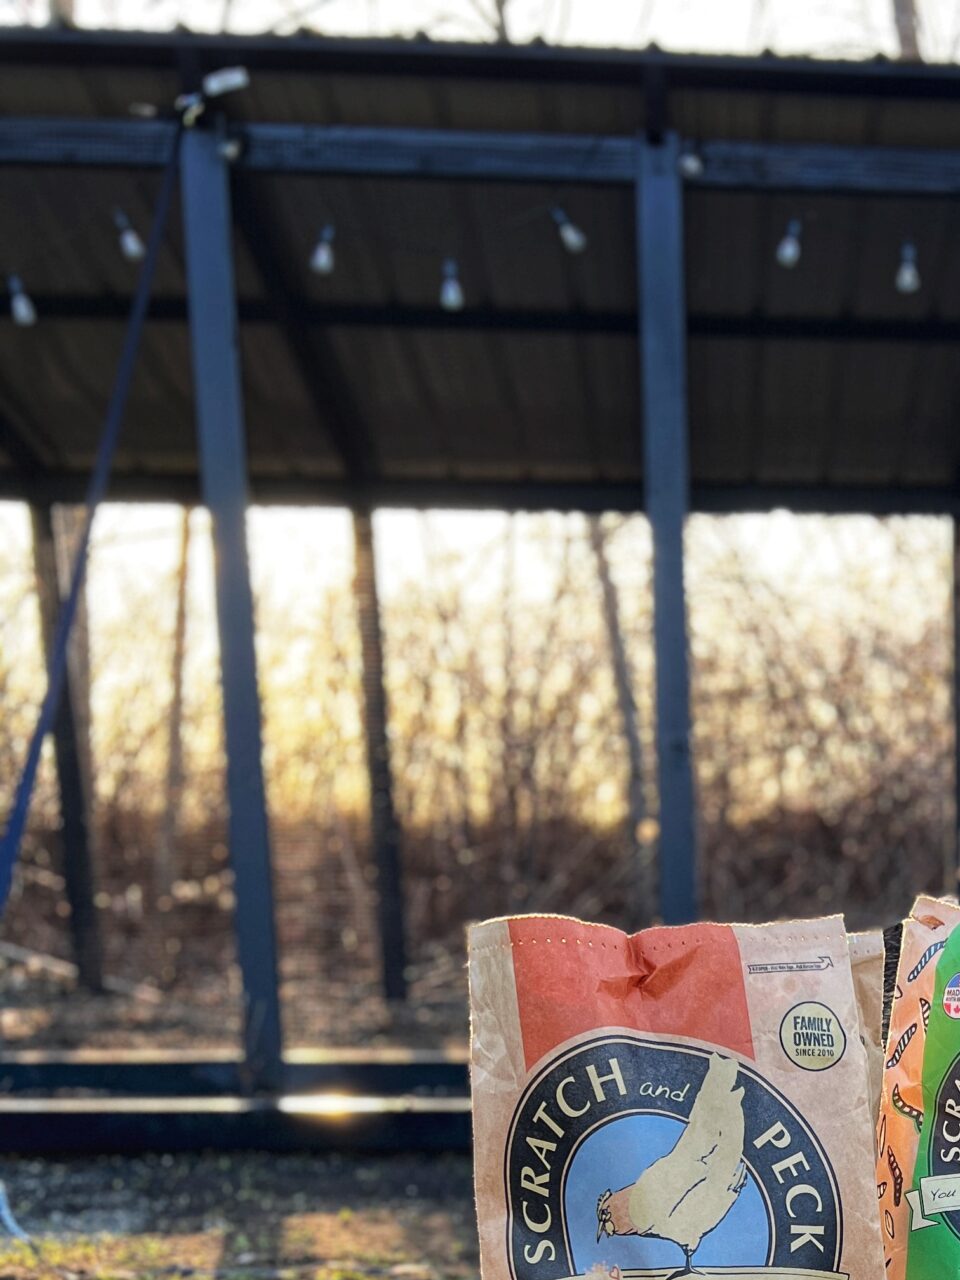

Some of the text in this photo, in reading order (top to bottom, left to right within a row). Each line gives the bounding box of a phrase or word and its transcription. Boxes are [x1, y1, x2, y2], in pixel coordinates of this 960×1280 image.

[793, 1016, 832, 1032] FAMILY
[793, 1032, 834, 1048] OWNED
[795, 1048, 834, 1057] SINCE 2010
[520, 1058, 825, 1264] SCRATCH and PECK
[930, 1189, 956, 1201] You
